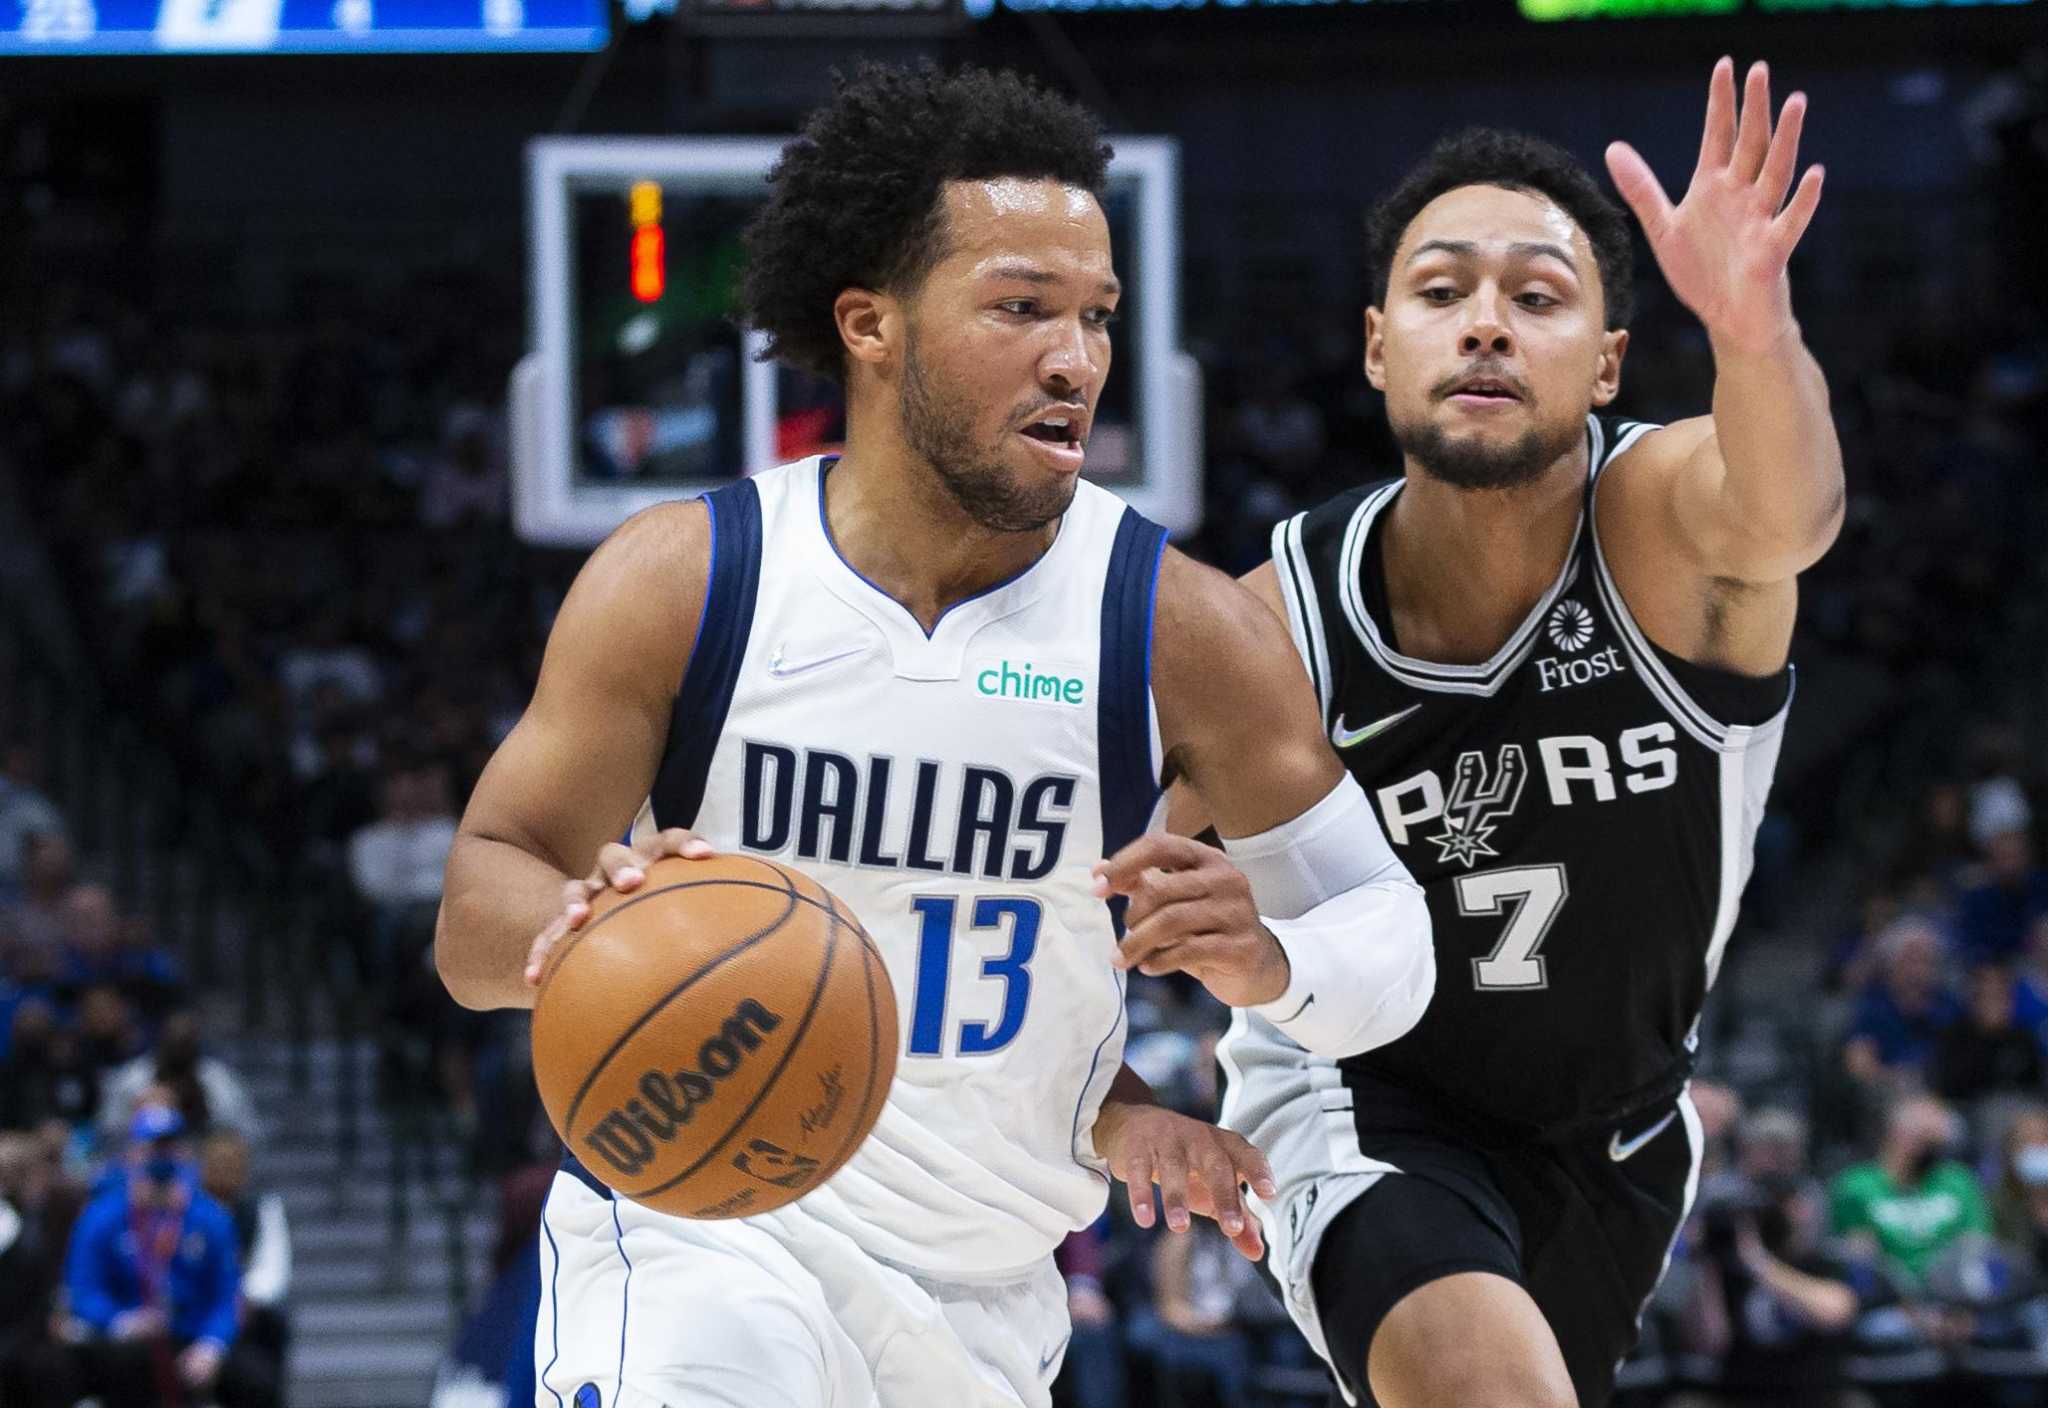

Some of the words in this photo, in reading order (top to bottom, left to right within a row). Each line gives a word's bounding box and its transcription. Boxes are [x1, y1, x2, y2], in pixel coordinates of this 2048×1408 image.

[977, 661, 1084, 704] chime
[1535, 645, 1625, 692] Frost
[739, 738, 1081, 882] DALLAS
[1377, 721, 1678, 868] PURS
[905, 893, 1044, 1058] 13
[1453, 863, 1569, 990] 7
[583, 998, 784, 1176] Wilson
